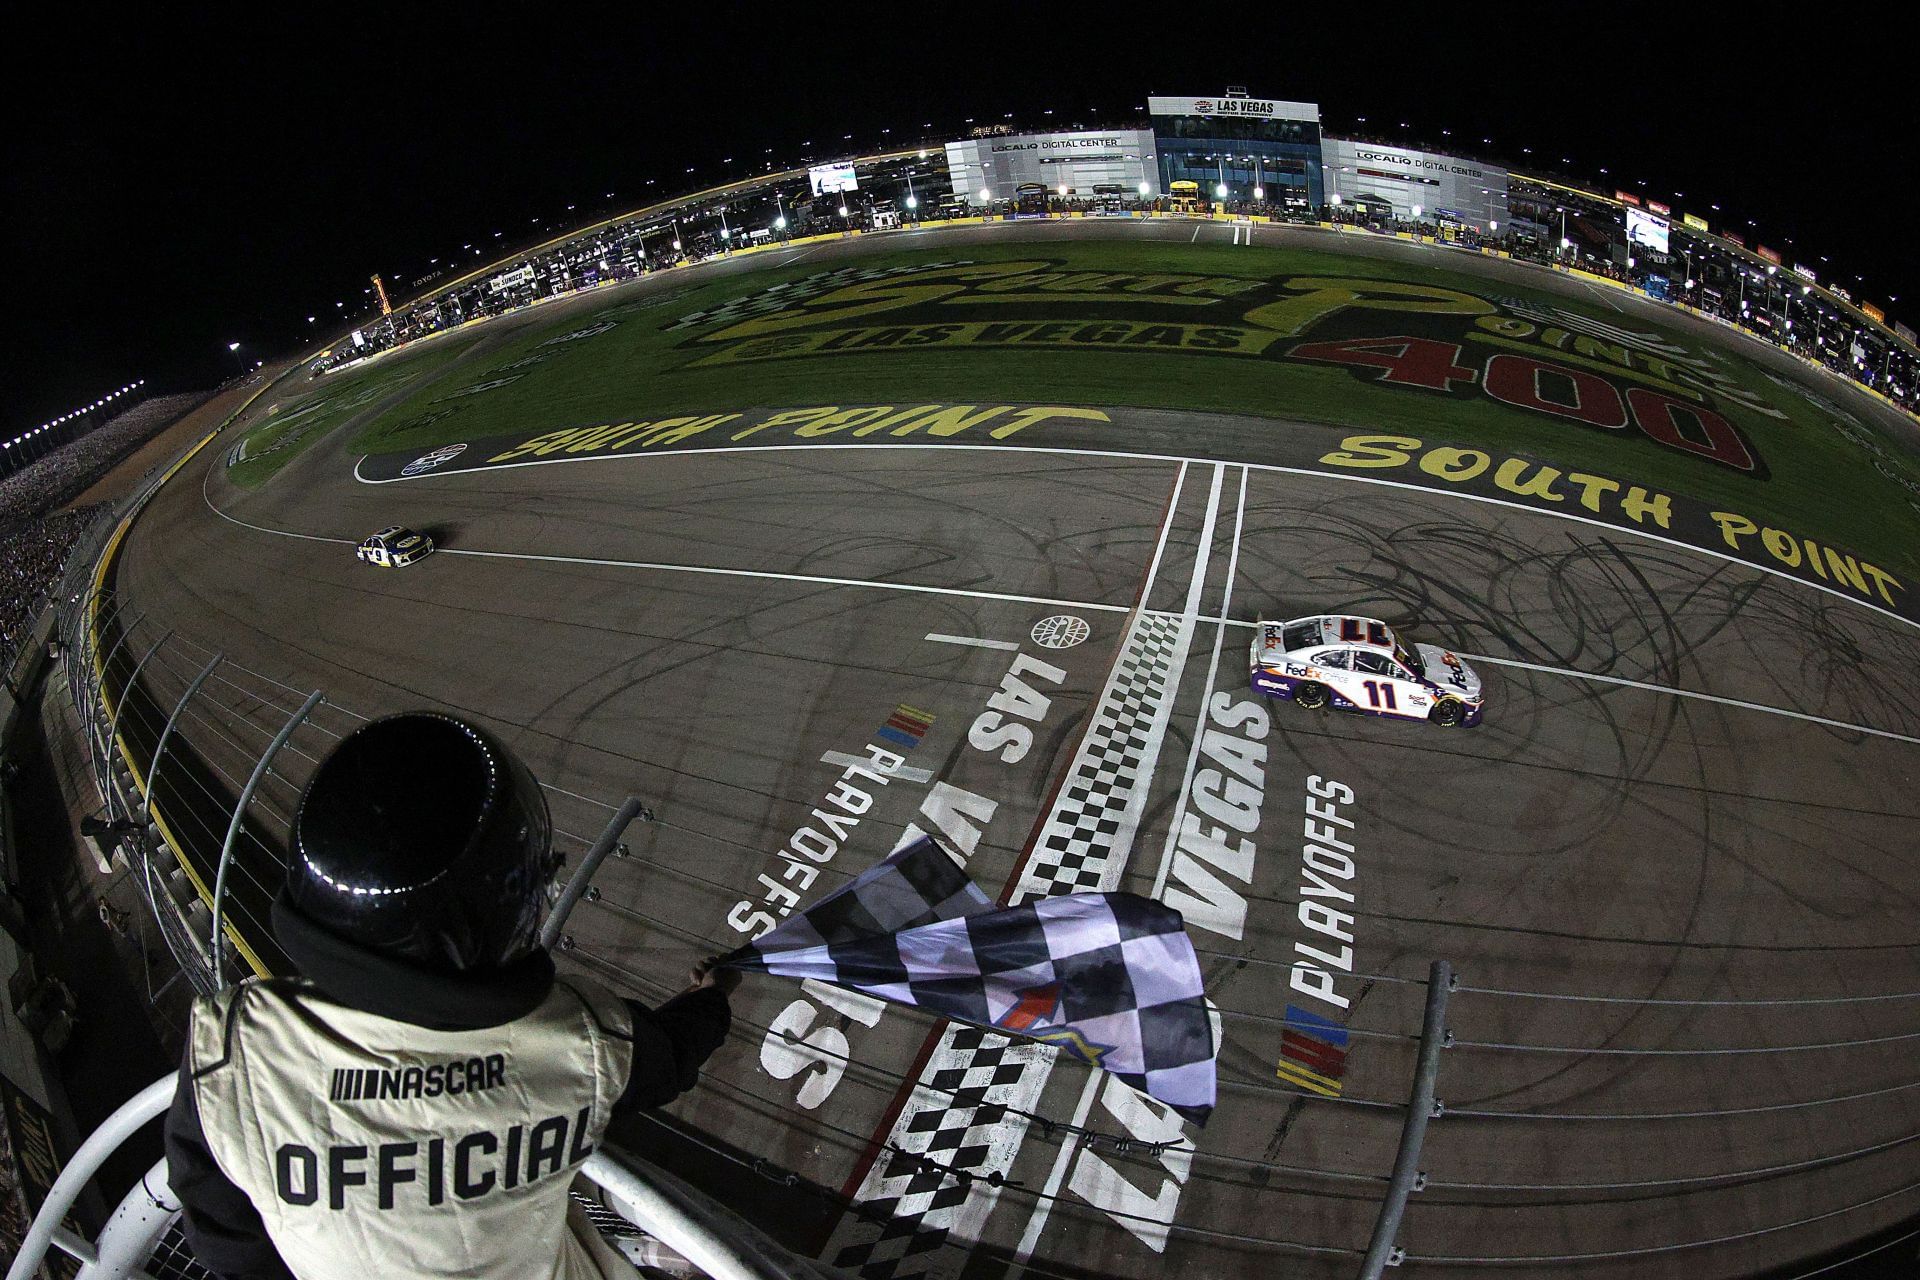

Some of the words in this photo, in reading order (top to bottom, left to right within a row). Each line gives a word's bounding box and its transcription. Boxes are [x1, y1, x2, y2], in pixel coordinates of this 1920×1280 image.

[1217, 100, 1238, 111] LAS
[1240, 101, 1274, 113] VEGAS
[1042, 140, 1078, 149] DIGITAL
[1079, 138, 1118, 148] CENTER
[1415, 159, 1450, 172] DIGITAL
[1451, 166, 1483, 179] CENTER
[501, 272, 523, 286] SUNOCO
[815, 324, 965, 351] LAS
[972, 321, 1245, 349] VEGAS
[1285, 335, 1756, 471] 400
[486, 413, 743, 463] SOUTH
[732, 404, 1112, 442] POINT
[1318, 434, 1672, 530] SOUTH
[1710, 511, 1905, 607] POINT
[1340, 617, 1392, 647] 11
[1285, 662, 1322, 679] FedEx
[968, 653, 1067, 765] LAS
[1362, 680, 1398, 710] 11
[727, 743, 906, 942] PLAYOFFS
[1289, 773, 1356, 1009] PLAYOFFS
[1067, 995, 1224, 1254] LA
[1163, 691, 1271, 941] VEGAS
[380, 1053, 506, 1100] NASCAR
[275, 1106, 594, 1211] OFFICIAL
